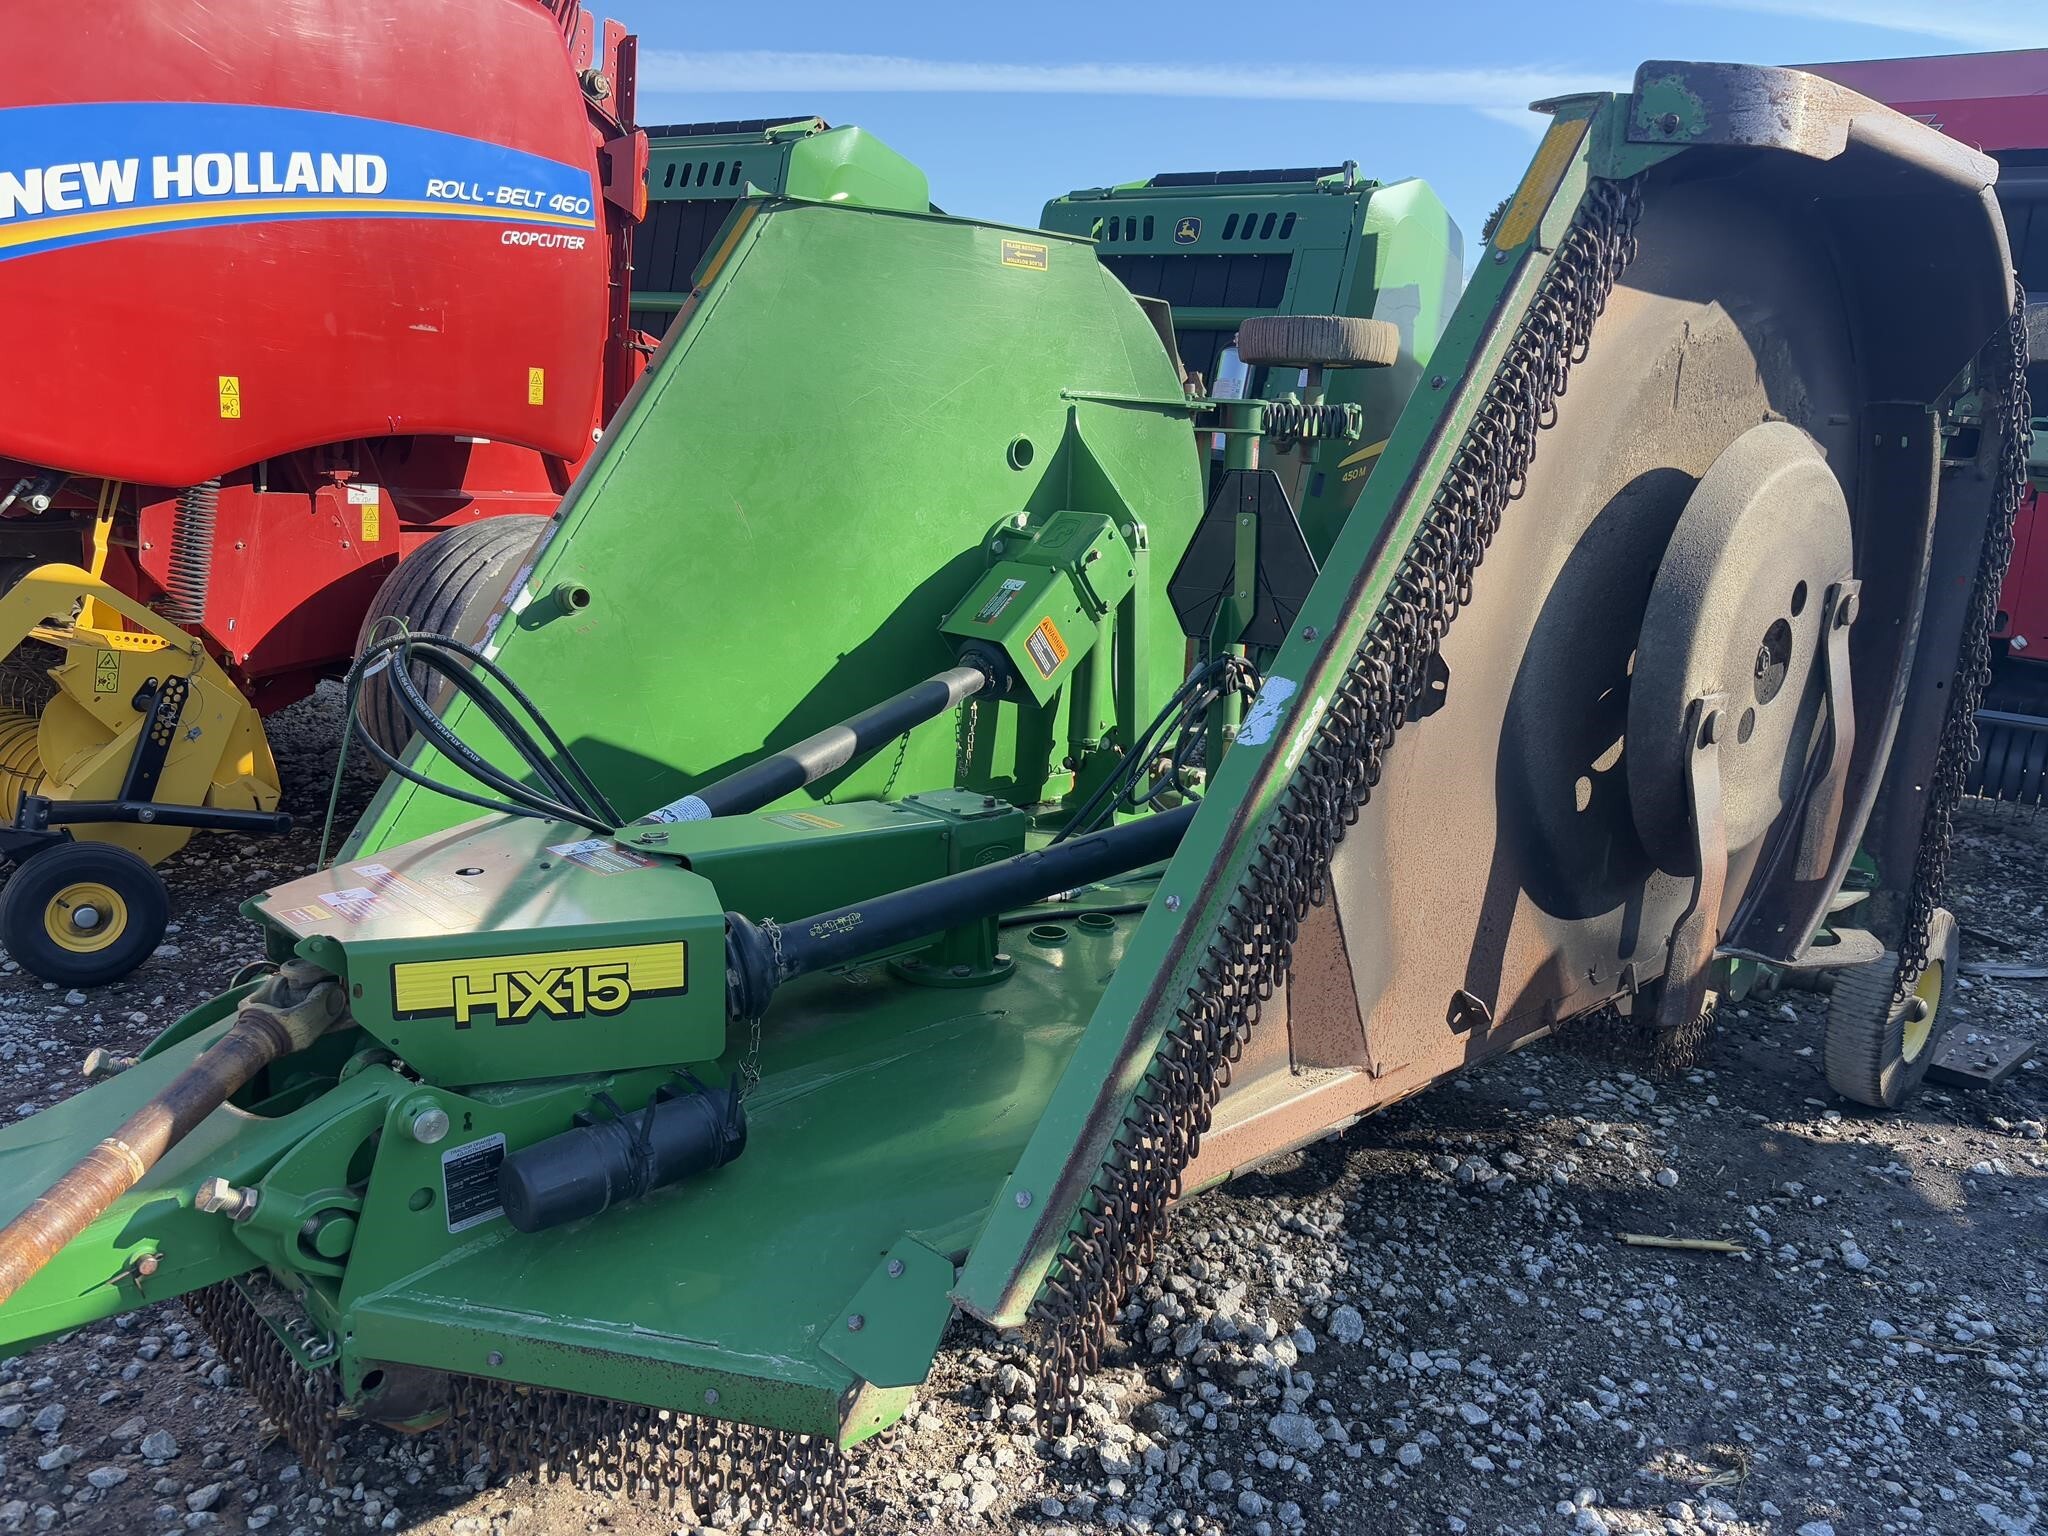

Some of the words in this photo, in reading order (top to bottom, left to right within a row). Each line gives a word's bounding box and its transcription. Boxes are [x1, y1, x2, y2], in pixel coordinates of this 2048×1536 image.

[0, 159, 139, 218] NEW
[152, 151, 388, 199] HOLLAND
[549, 194, 590, 215] 460
[501, 230, 585, 250] CROPCUTTER
[1047, 626, 1067, 658] WARNING
[413, 697, 426, 712] INCH
[462, 746, 480, 762] ATLAS
